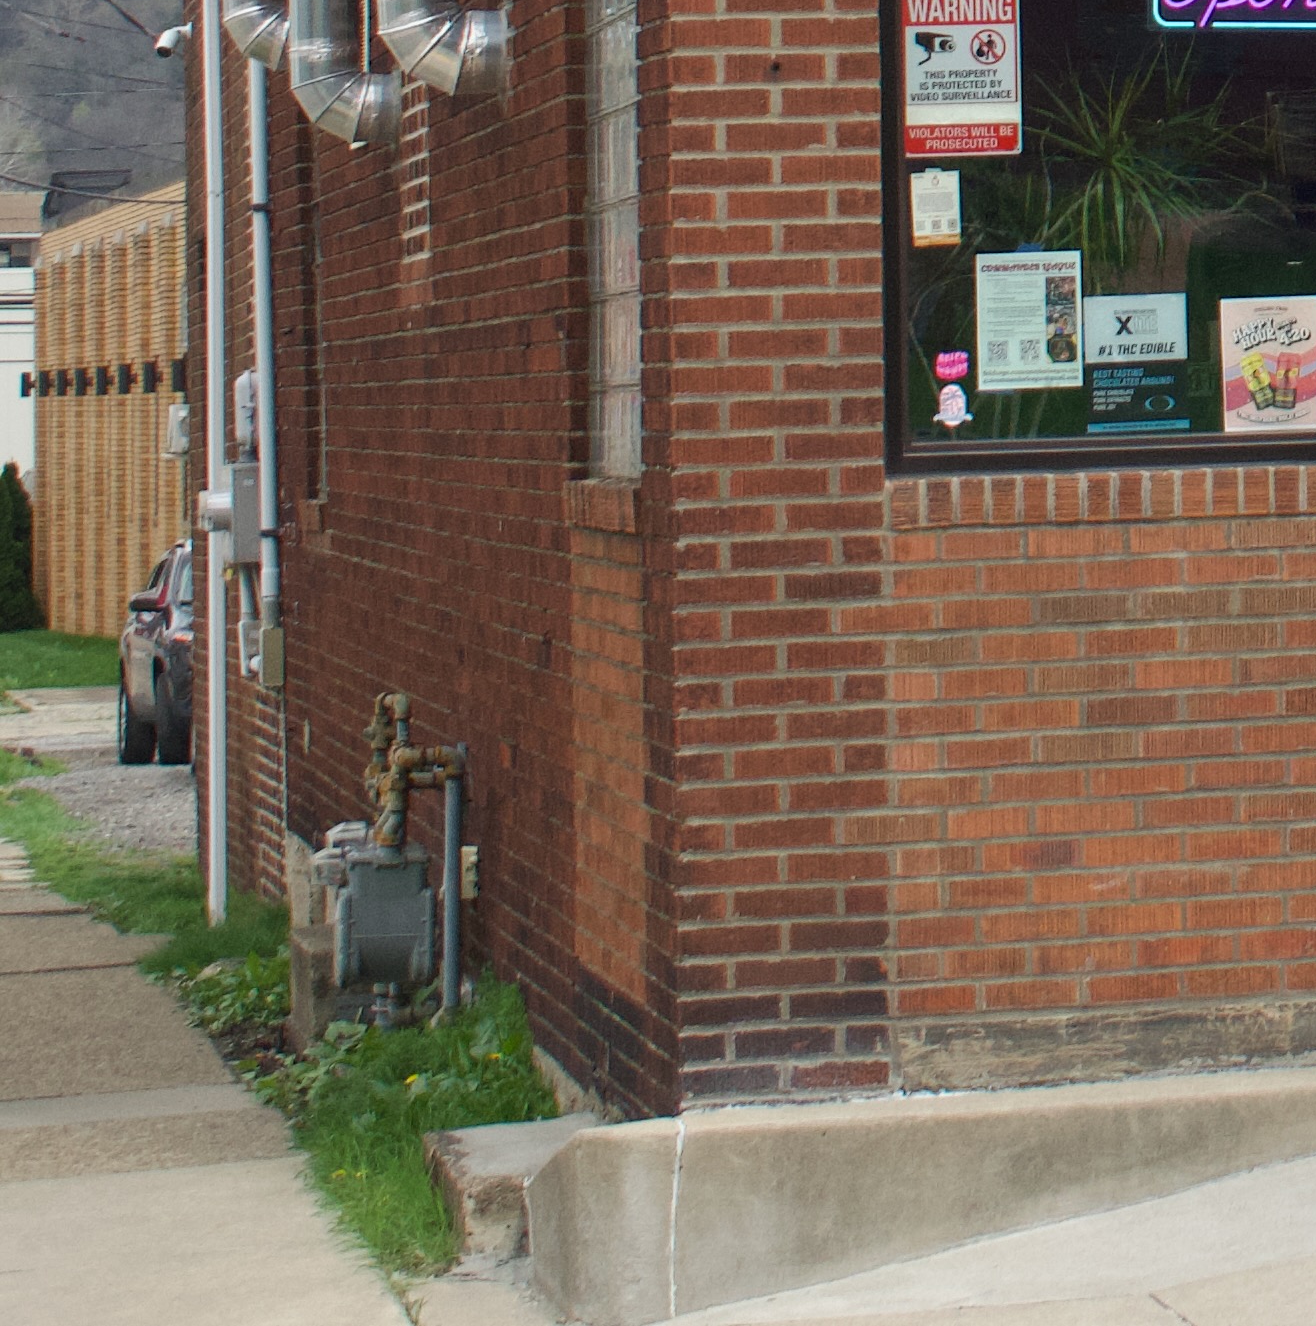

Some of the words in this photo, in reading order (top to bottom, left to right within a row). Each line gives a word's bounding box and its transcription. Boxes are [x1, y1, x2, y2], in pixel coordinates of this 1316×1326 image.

[923, 69, 946, 80] THIS
[948, 68, 998, 79] PROPERTY
[919, 81, 929, 91] IS
[931, 80, 987, 91] PROTECTED
[989, 79, 1003, 89] BY
[910, 92, 939, 102] VIDEO
[941, 89, 1013, 101] SURVEILLANCE
[908, 127, 968, 139] VIOLATORS
[971, 126, 998, 137] WILL
[1000, 125, 1014, 136] BE
[925, 138, 998, 150] PROSECUTED
[1232, 317, 1275, 344] HAPPY
[1240, 327, 1277, 351] HOUR
[1098, 344, 1114, 357] #1
[1117, 343, 1138, 356] THC
[1139, 341, 1177, 355] EDIBLE
